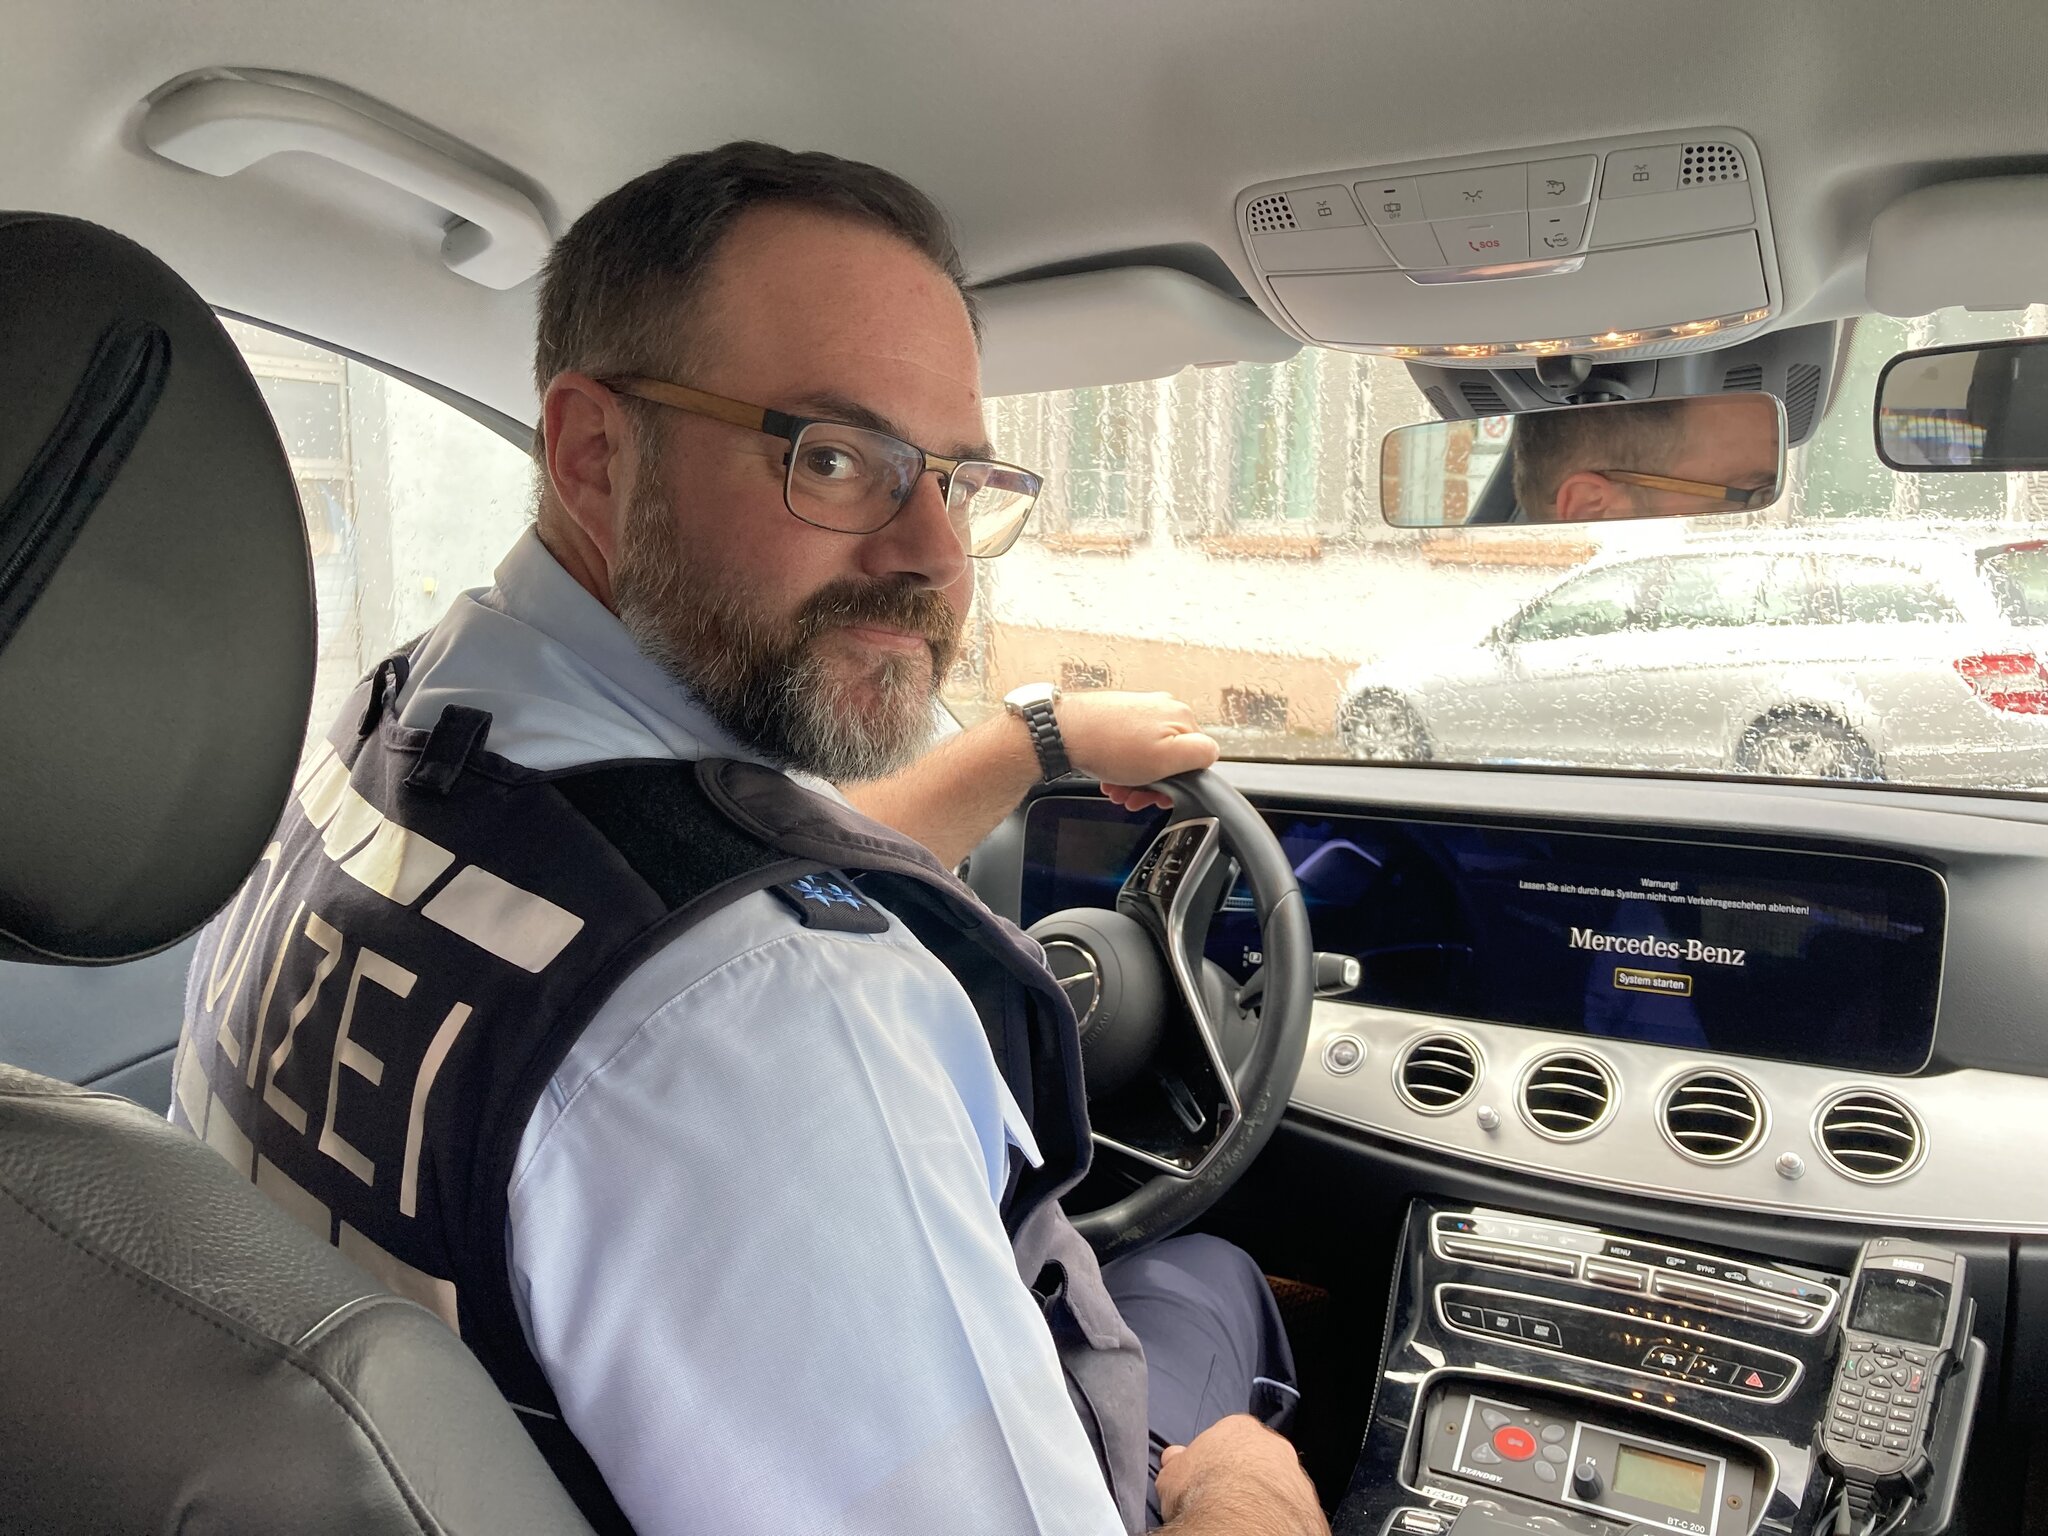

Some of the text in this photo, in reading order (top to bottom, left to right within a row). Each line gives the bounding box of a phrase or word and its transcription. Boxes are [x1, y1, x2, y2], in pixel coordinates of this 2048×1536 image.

[1479, 239, 1500, 249] SOS
[1640, 878, 1679, 891] Warnung!
[1519, 880, 1810, 915] Lassen Sie sich durch das System nicht vom Verkehrsgeschehen ablenken!
[1569, 926, 1746, 967] Mercedes-Benz
[1619, 972, 1685, 990] System starten
[205, 840, 473, 1219] OLIZEI
[1610, 1246, 1631, 1256] MENU
[1696, 1264, 1716, 1274] SYNC
[1758, 1279, 1773, 1288] A/C
[1585, 1456, 1596, 1466] F4
[1667, 1516, 1705, 1533] BT-C 200
